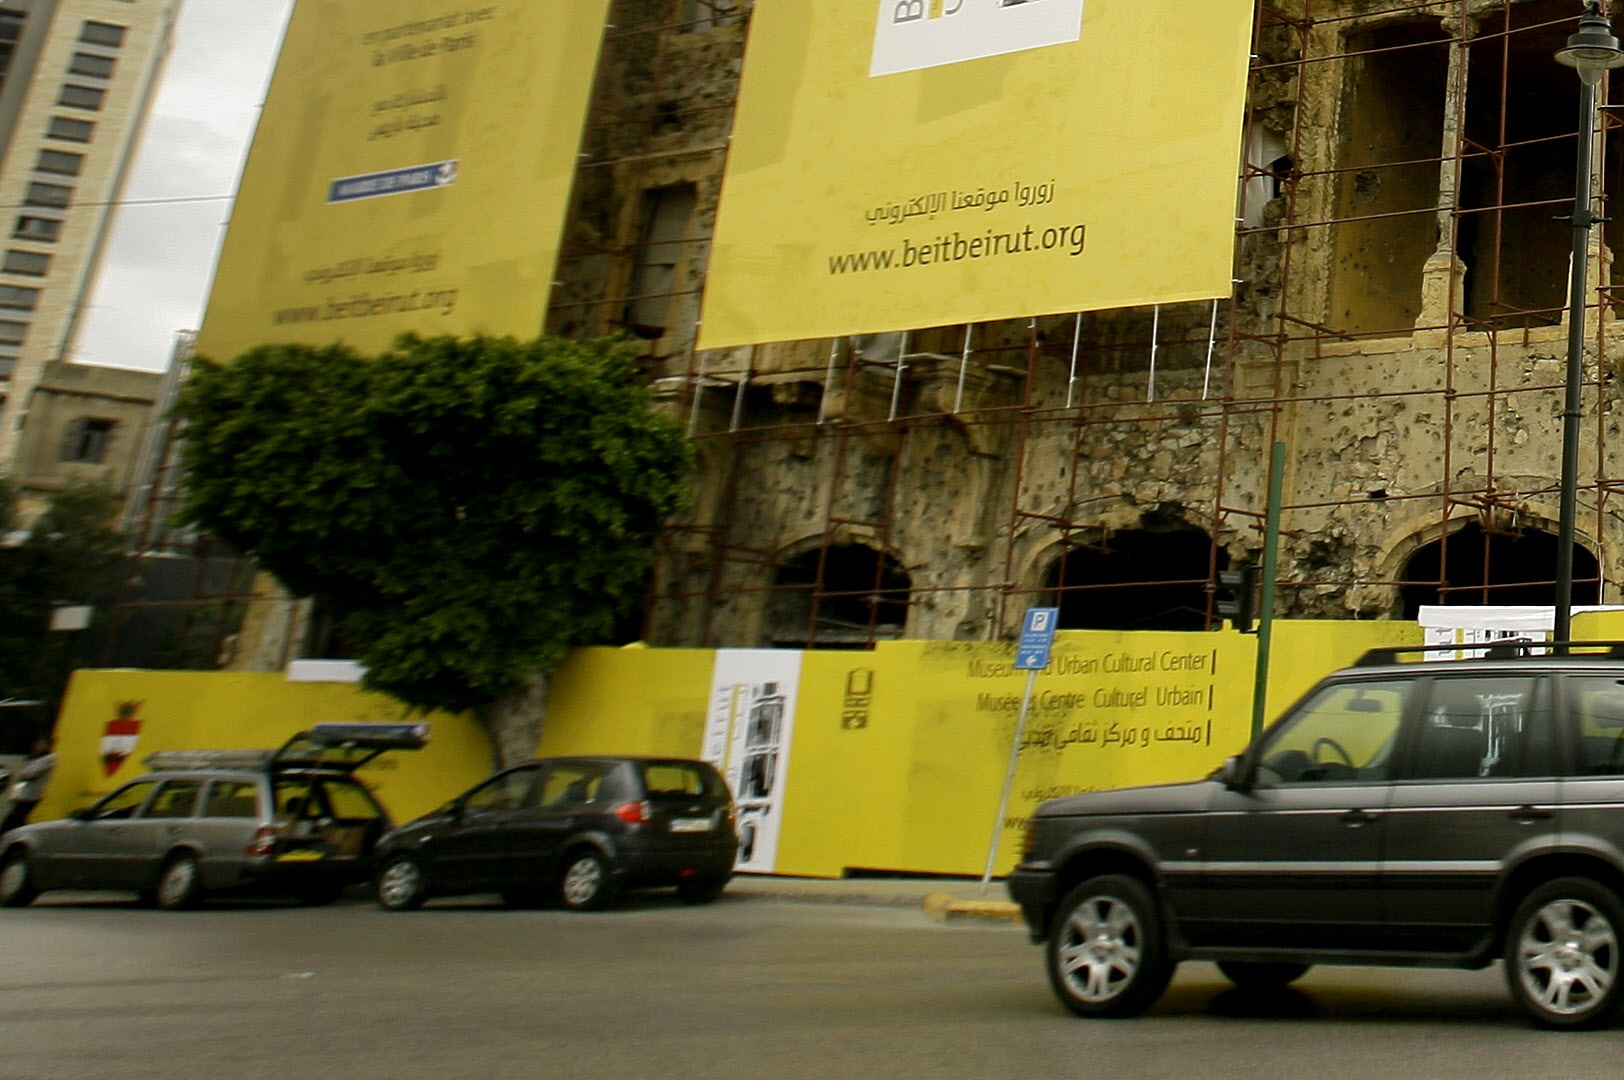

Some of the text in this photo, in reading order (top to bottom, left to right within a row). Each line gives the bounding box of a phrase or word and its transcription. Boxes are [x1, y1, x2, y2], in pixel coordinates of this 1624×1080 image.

[951, 188, 1009, 213] موقعنا
[1014, 179, 1056, 207] زوروا
[828, 223, 1087, 276] www.beitbeirut.org
[1056, 654, 1098, 676] Urban
[1101, 651, 1155, 673] Cultural
[1159, 649, 1208, 671] Center
[1156, 684, 1203, 706] Urbain
[1153, 720, 1202, 744] متحف
